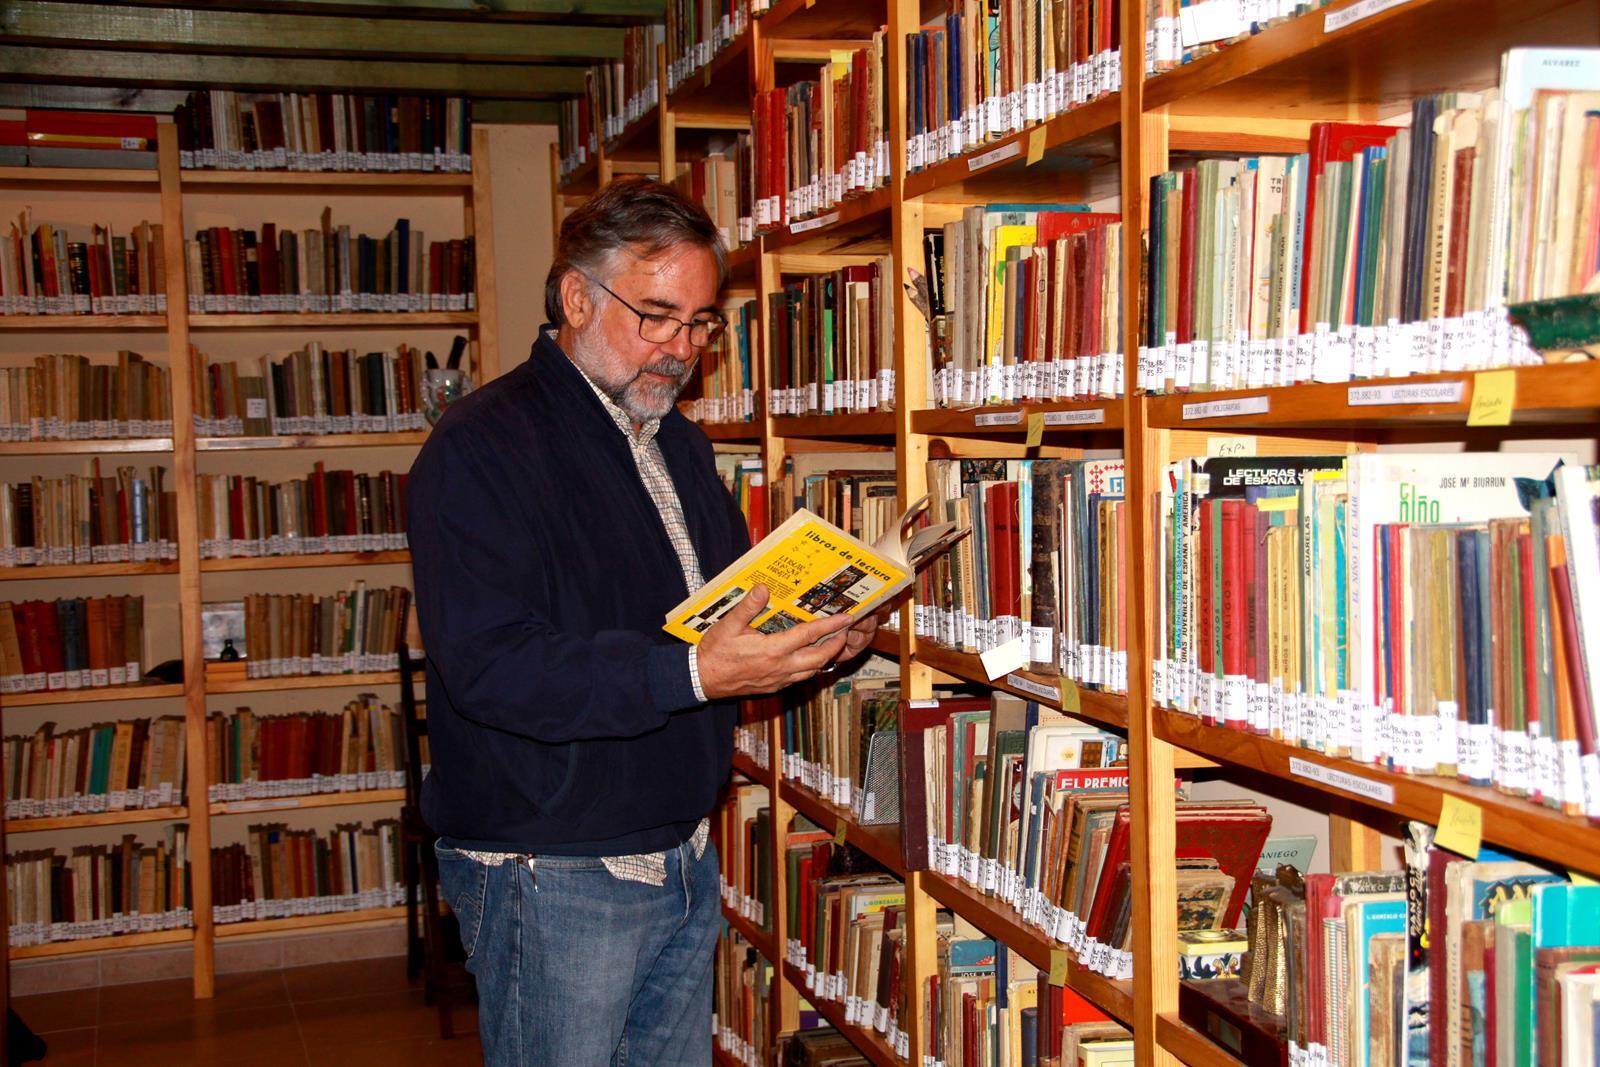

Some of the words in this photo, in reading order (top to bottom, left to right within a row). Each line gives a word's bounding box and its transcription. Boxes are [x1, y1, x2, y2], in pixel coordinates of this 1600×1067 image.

[1228, 468, 1296, 478] LECTURAS
[1223, 477, 1241, 486] DE
[1473, 477, 1506, 488] BIURRUN
[804, 530, 837, 552] libros
[839, 549, 853, 561] de
[855, 558, 892, 582] lectura
[1182, 579, 1188, 590] DE
[1061, 778, 1081, 789] EL
